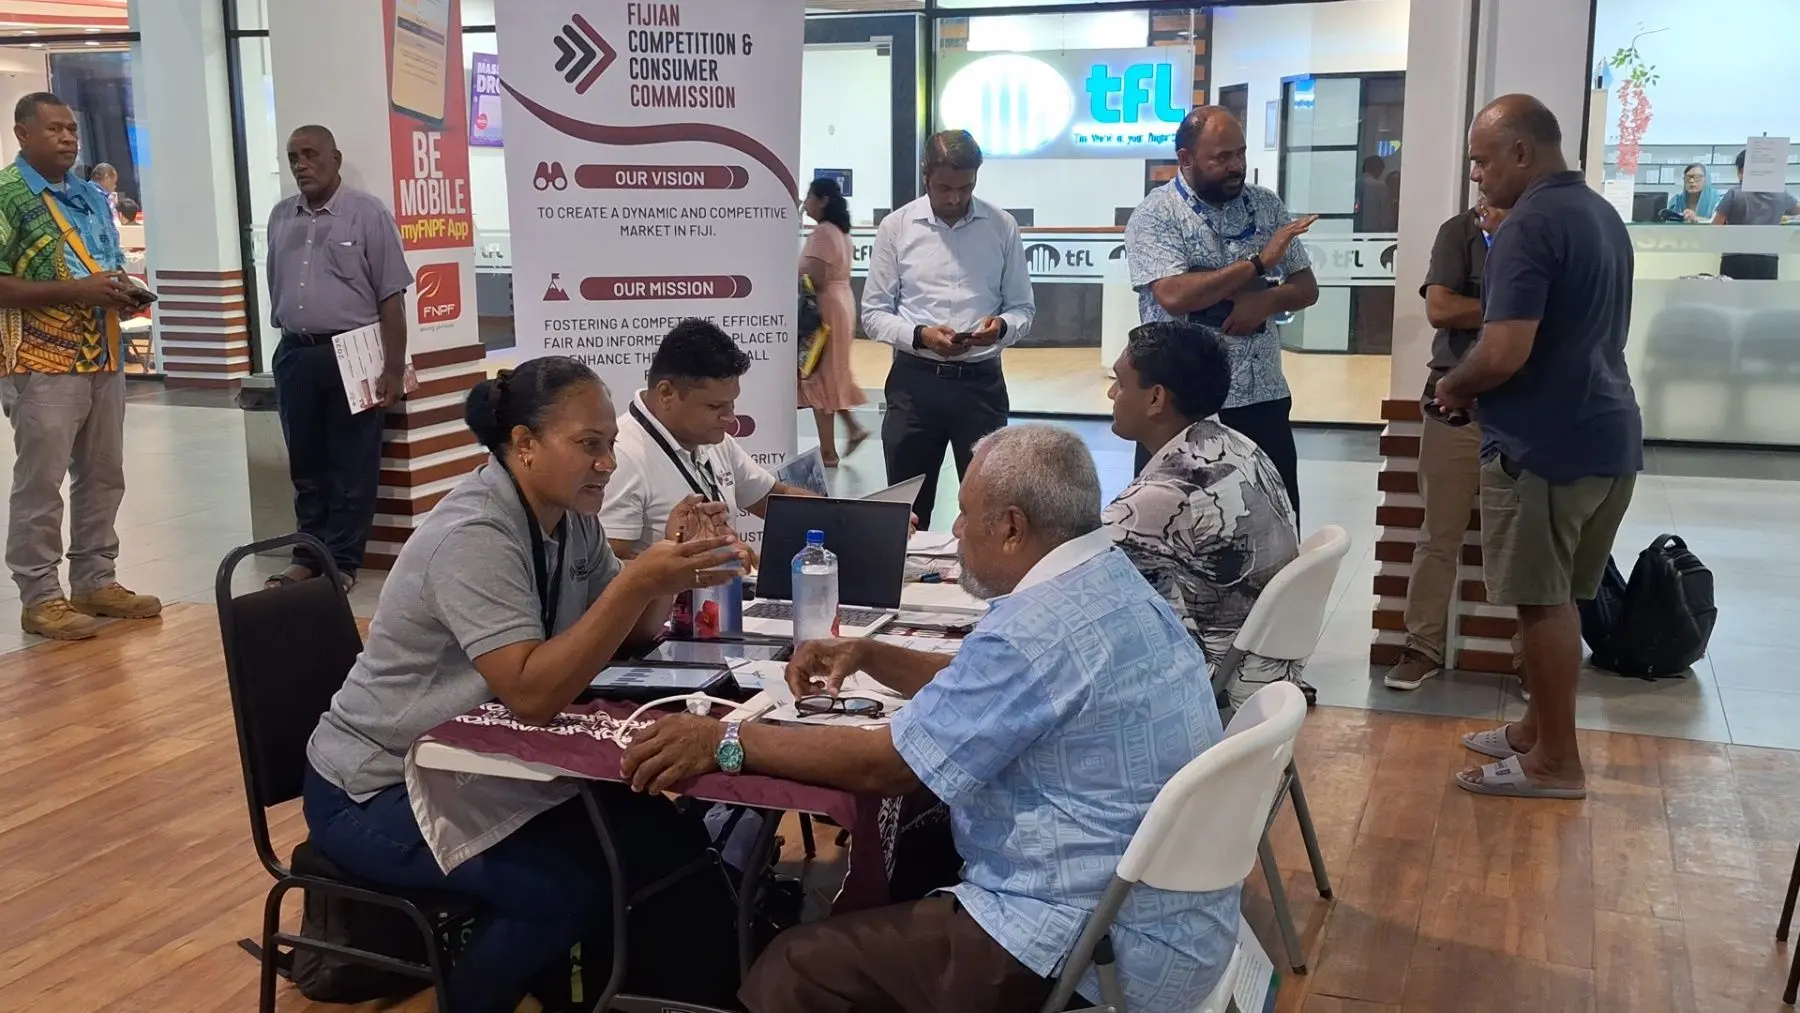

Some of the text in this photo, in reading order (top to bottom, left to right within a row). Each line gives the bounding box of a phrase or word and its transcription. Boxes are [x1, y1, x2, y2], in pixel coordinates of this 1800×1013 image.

[627, 3, 680, 26] FIJIAN
[628, 30, 753, 55] COMPETITION &
[629, 57, 719, 81] CONSUMER
[630, 84, 736, 108] COMMISSION
[412, 131, 443, 179] BE
[615, 170, 705, 186] OUR VISION
[400, 179, 466, 216] MOBILE
[537, 206, 788, 219] TO CREATE A DYNAMIC AND COMPETITIVE
[401, 218, 469, 243] myFNPF App
[620, 225, 716, 237] MARKET IN FIJI.
[613, 281, 714, 297] OUR MISSION
[423, 303, 456, 318] FNPF
[544, 318, 618, 332] FOSTERING
[621, 318, 629, 329] A
[544, 337, 573, 349] FAIR
[577, 336, 604, 348] AND
[776, 331, 789, 343] TO
[750, 452, 786, 465] GRITY
